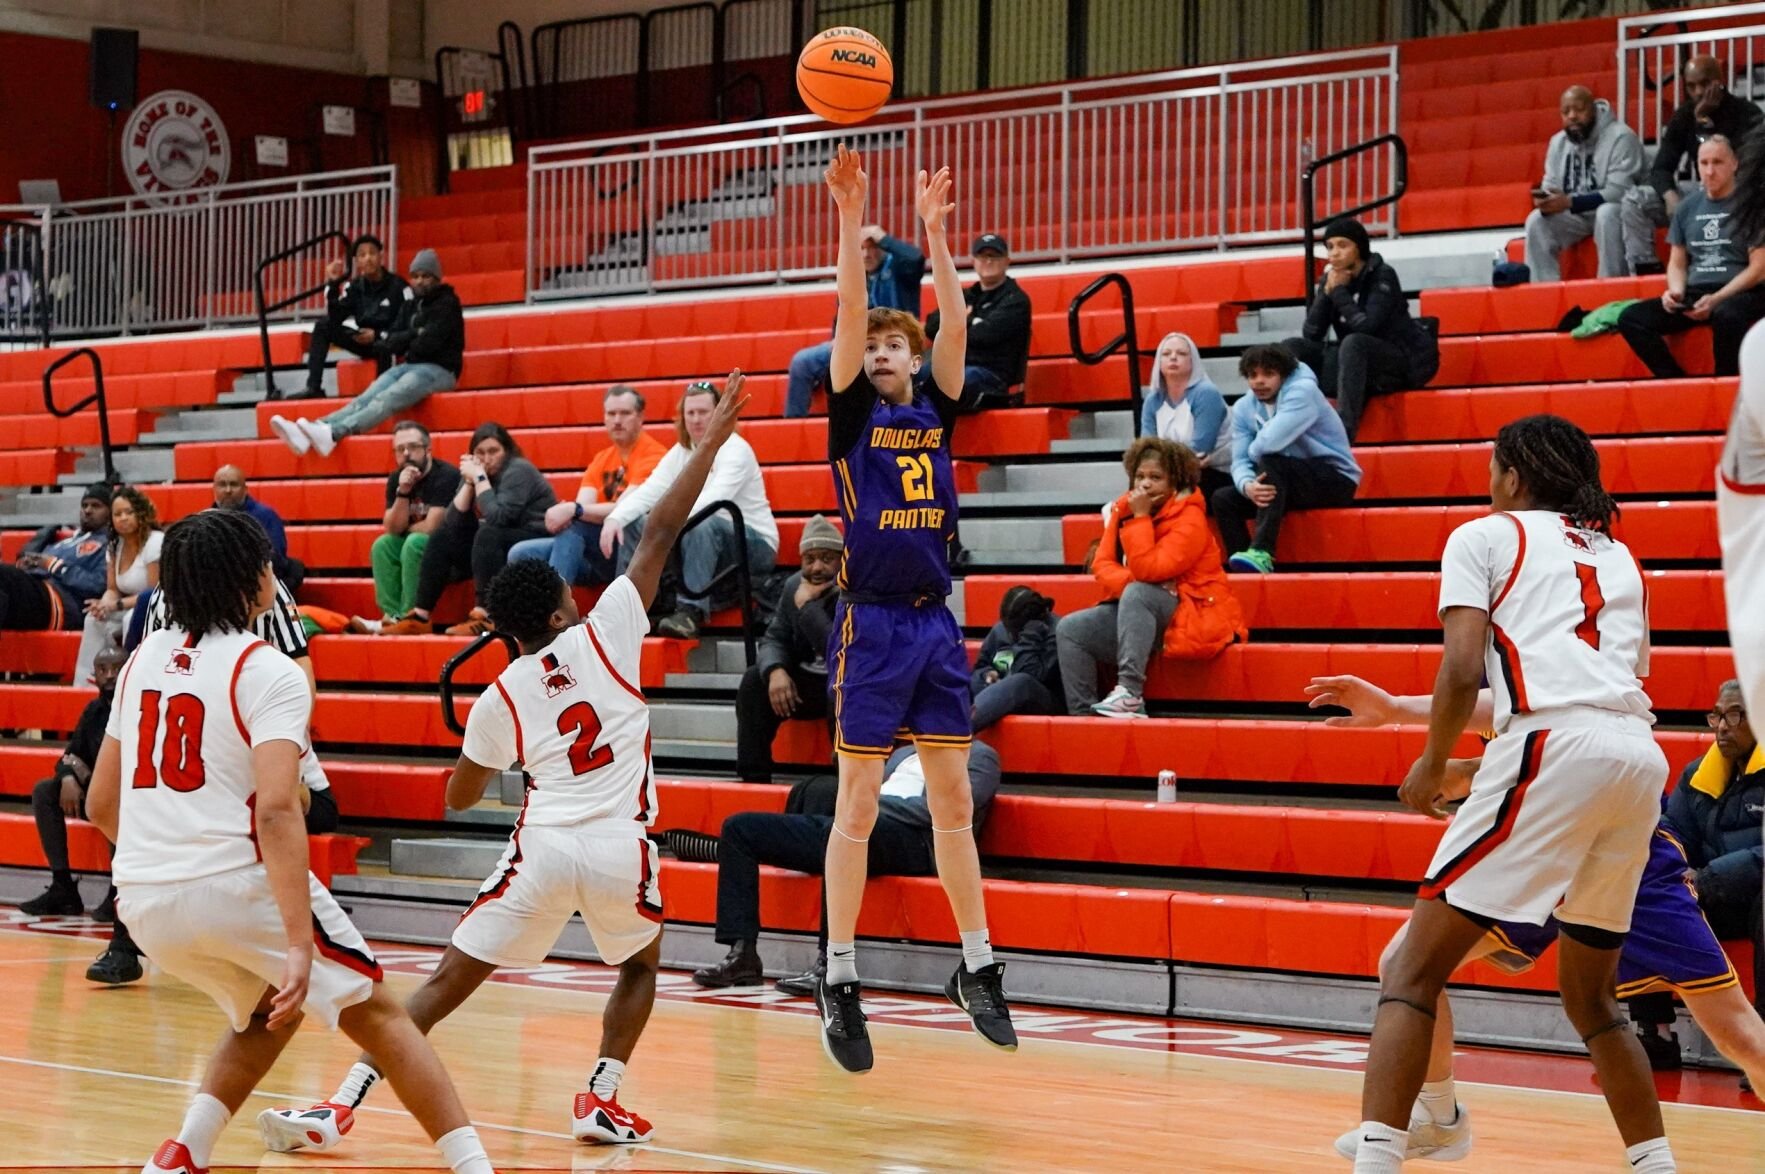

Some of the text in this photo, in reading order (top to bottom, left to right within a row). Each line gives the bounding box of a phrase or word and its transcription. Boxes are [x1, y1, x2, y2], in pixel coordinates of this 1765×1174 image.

[831, 48, 876, 68] NCAA
[133, 101, 221, 156] HOME OF THE
[896, 453, 934, 502] 21
[1573, 560, 1605, 652] 1
[132, 689, 206, 793] 10
[557, 701, 615, 776] 2
